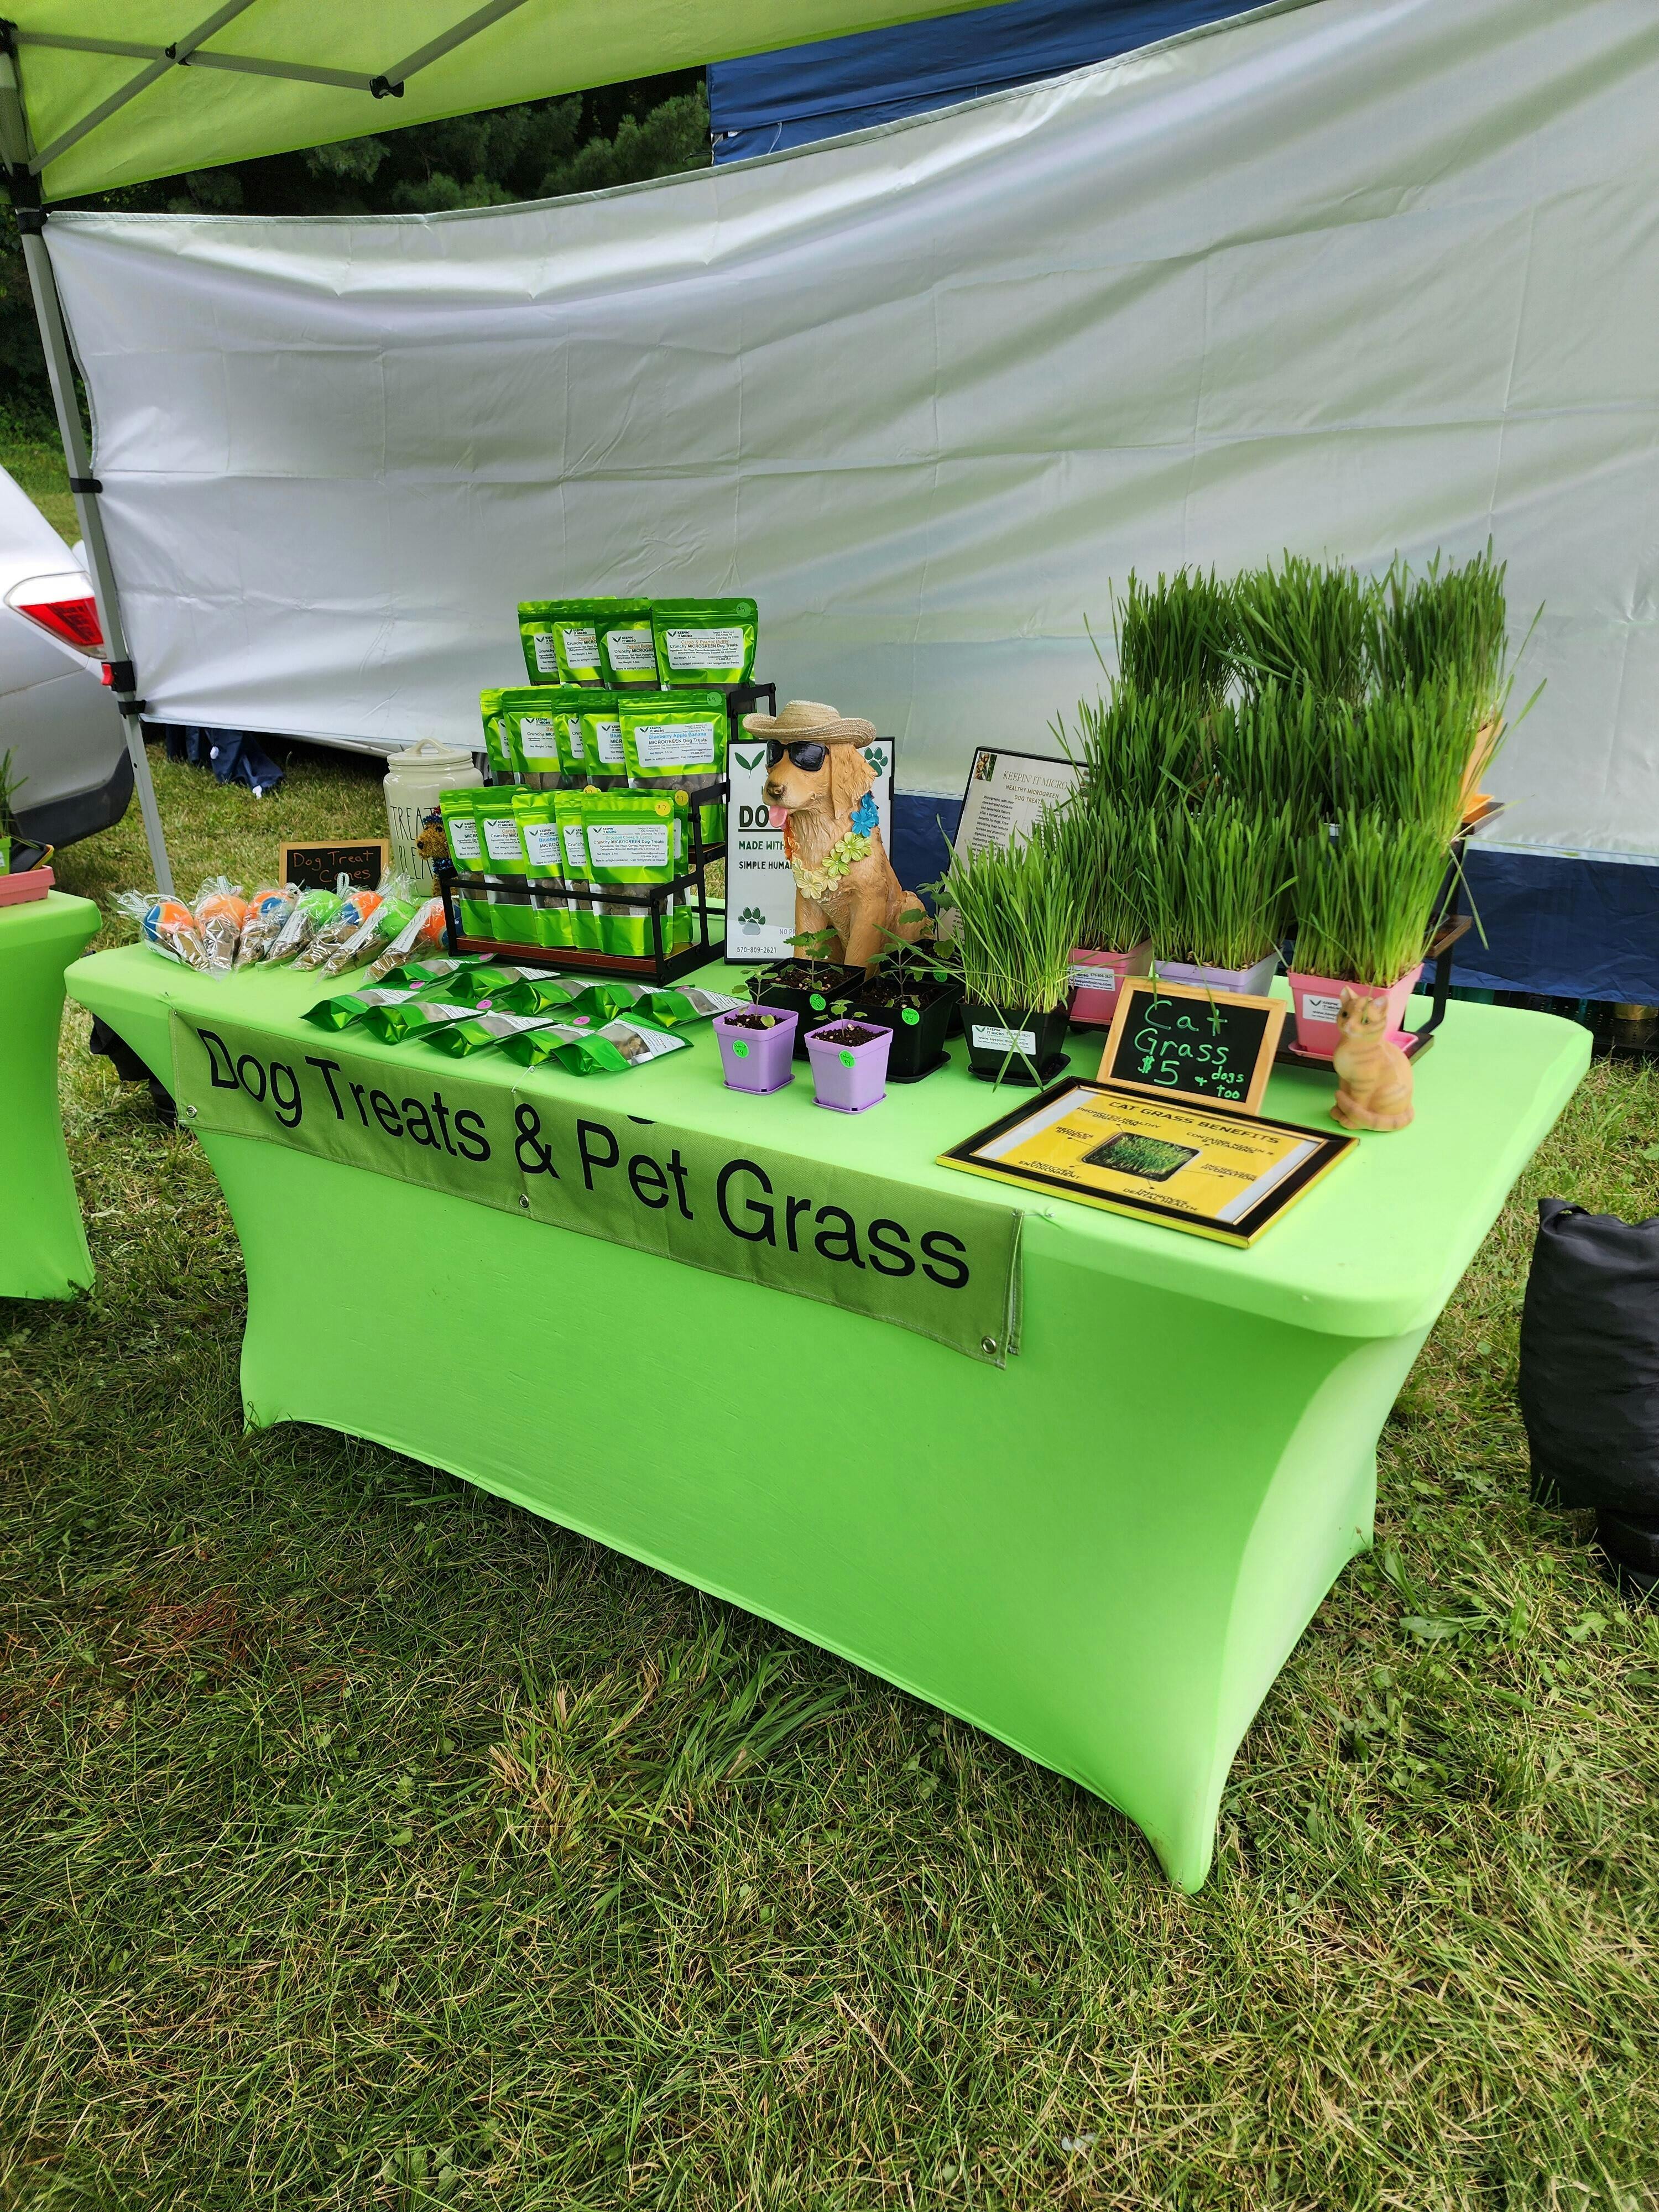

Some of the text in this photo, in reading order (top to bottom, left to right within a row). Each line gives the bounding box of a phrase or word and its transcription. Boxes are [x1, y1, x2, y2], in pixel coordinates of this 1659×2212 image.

[1003, 770, 1068, 790] KEEPIN' IT MICRO
[1005, 784, 1059, 799] HEALTHY MICROGREEN
[739, 805, 769, 828] DO
[739, 841, 763, 850] MADE
[293, 850, 374, 871] Dog Treat
[399, 846, 434, 880] PLEA
[739, 861, 792, 869] SIMPLE HUMA
[1144, 1000, 1228, 1036] Cat
[978, 1036, 1029, 1046] www.keepinitmic.com
[1134, 1027, 1229, 1065] Grass
[1211, 1066, 1244, 1084] dogs
[1217, 1084, 1240, 1099] too
[1076, 1107, 1161, 1128] PROMOTES HEALTHY
[1092, 1114, 1138, 1126] DIGESTION
[1109, 1102, 1281, 1144] CAT GRASS BENEFITS
[1056, 1126, 1094, 1138] REDUCES
[1186, 1132, 1230, 1145] CONTAINS
[197, 1028, 971, 1290] Dog Treats & Pet Grass
[1019, 1160, 1082, 1179] ENVIRONMENT
[1201, 1165, 1256, 1181] HYDRATION
[1123, 1188, 1198, 1211] DENTAL HEALTH
